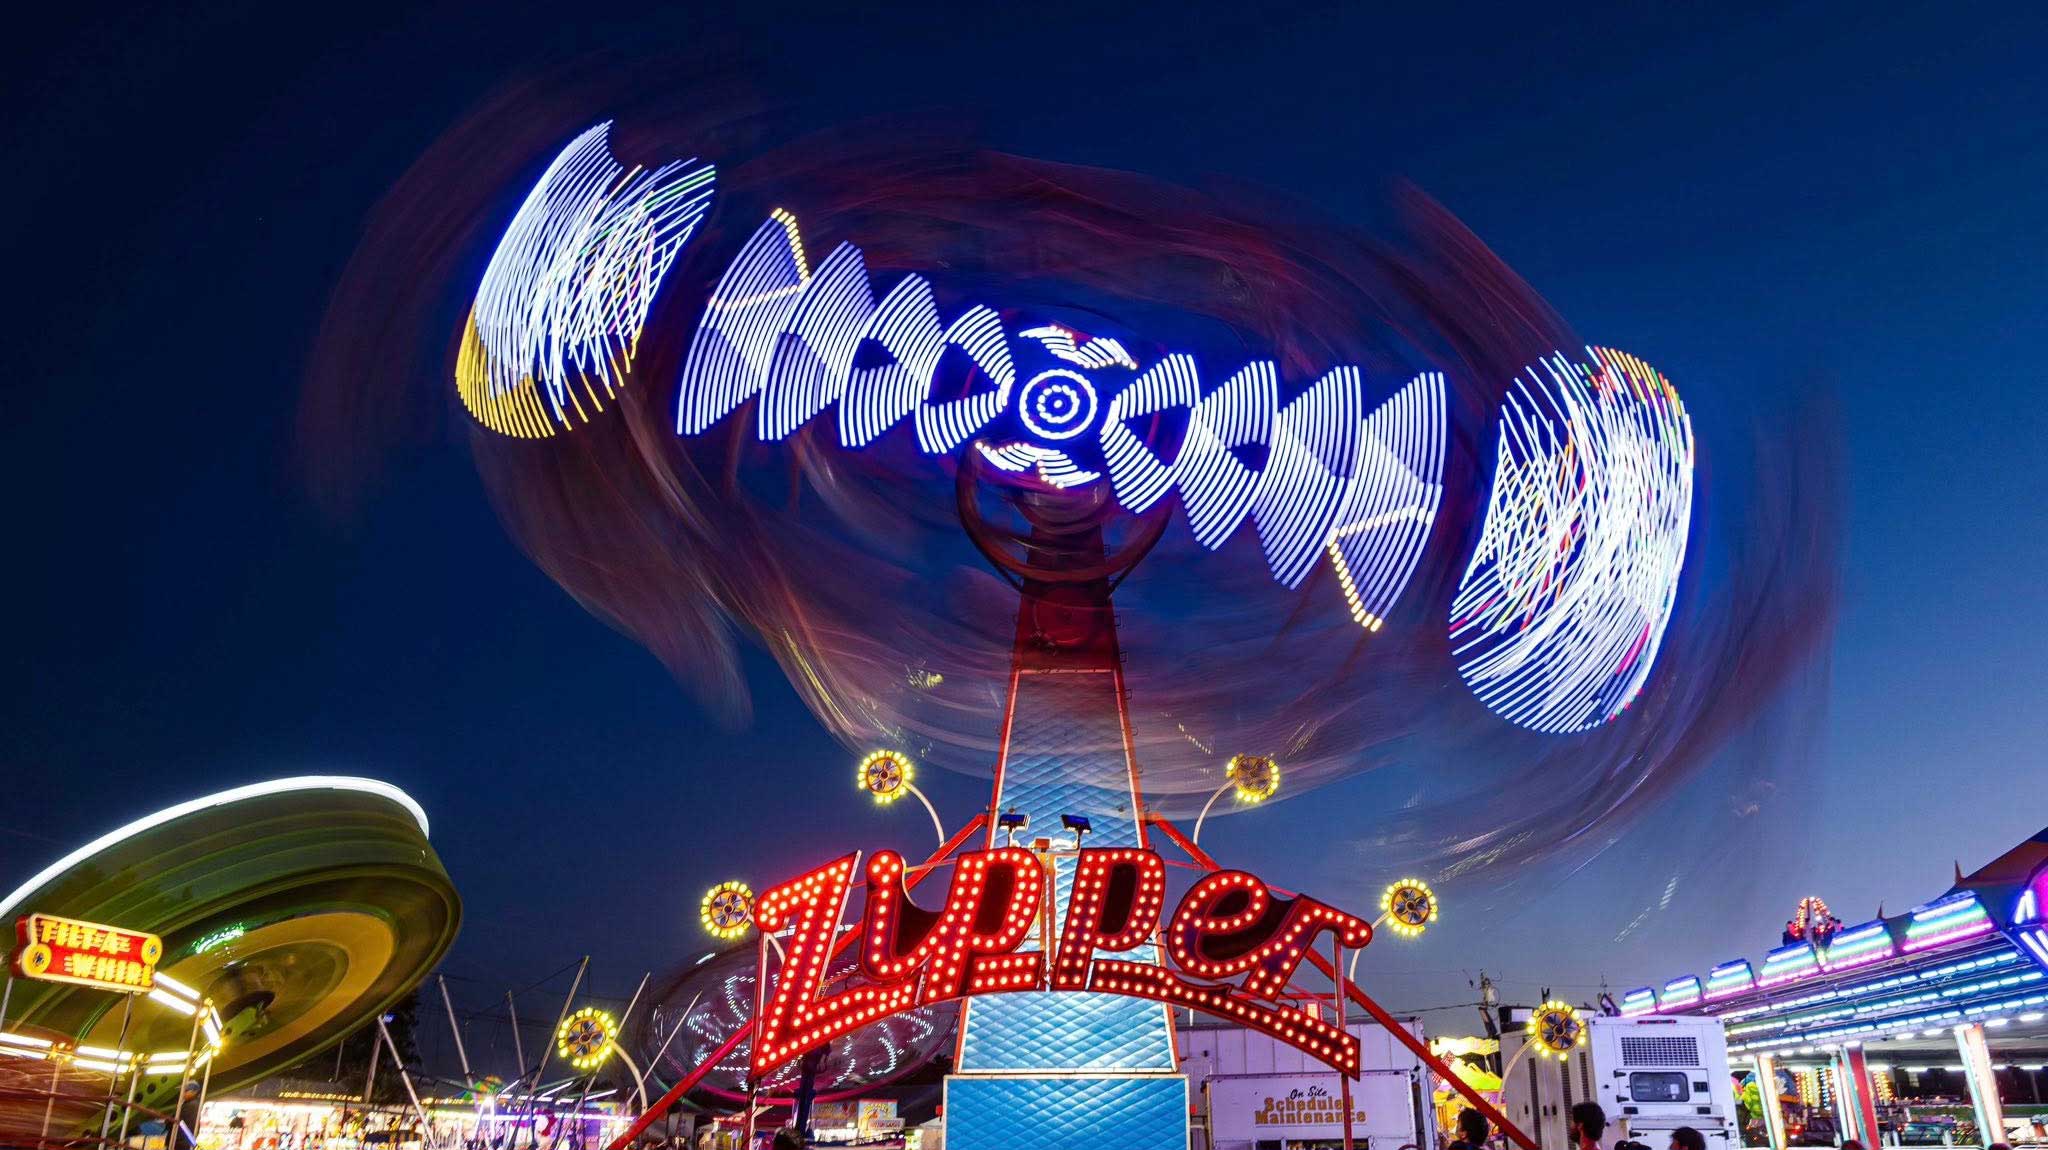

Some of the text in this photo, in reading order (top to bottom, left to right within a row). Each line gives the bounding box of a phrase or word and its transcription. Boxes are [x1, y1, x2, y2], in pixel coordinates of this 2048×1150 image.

[71, 953, 153, 987] WHIRL
[752, 847, 1373, 1080] Zipper
[1290, 1086, 1328, 1100] On Site
